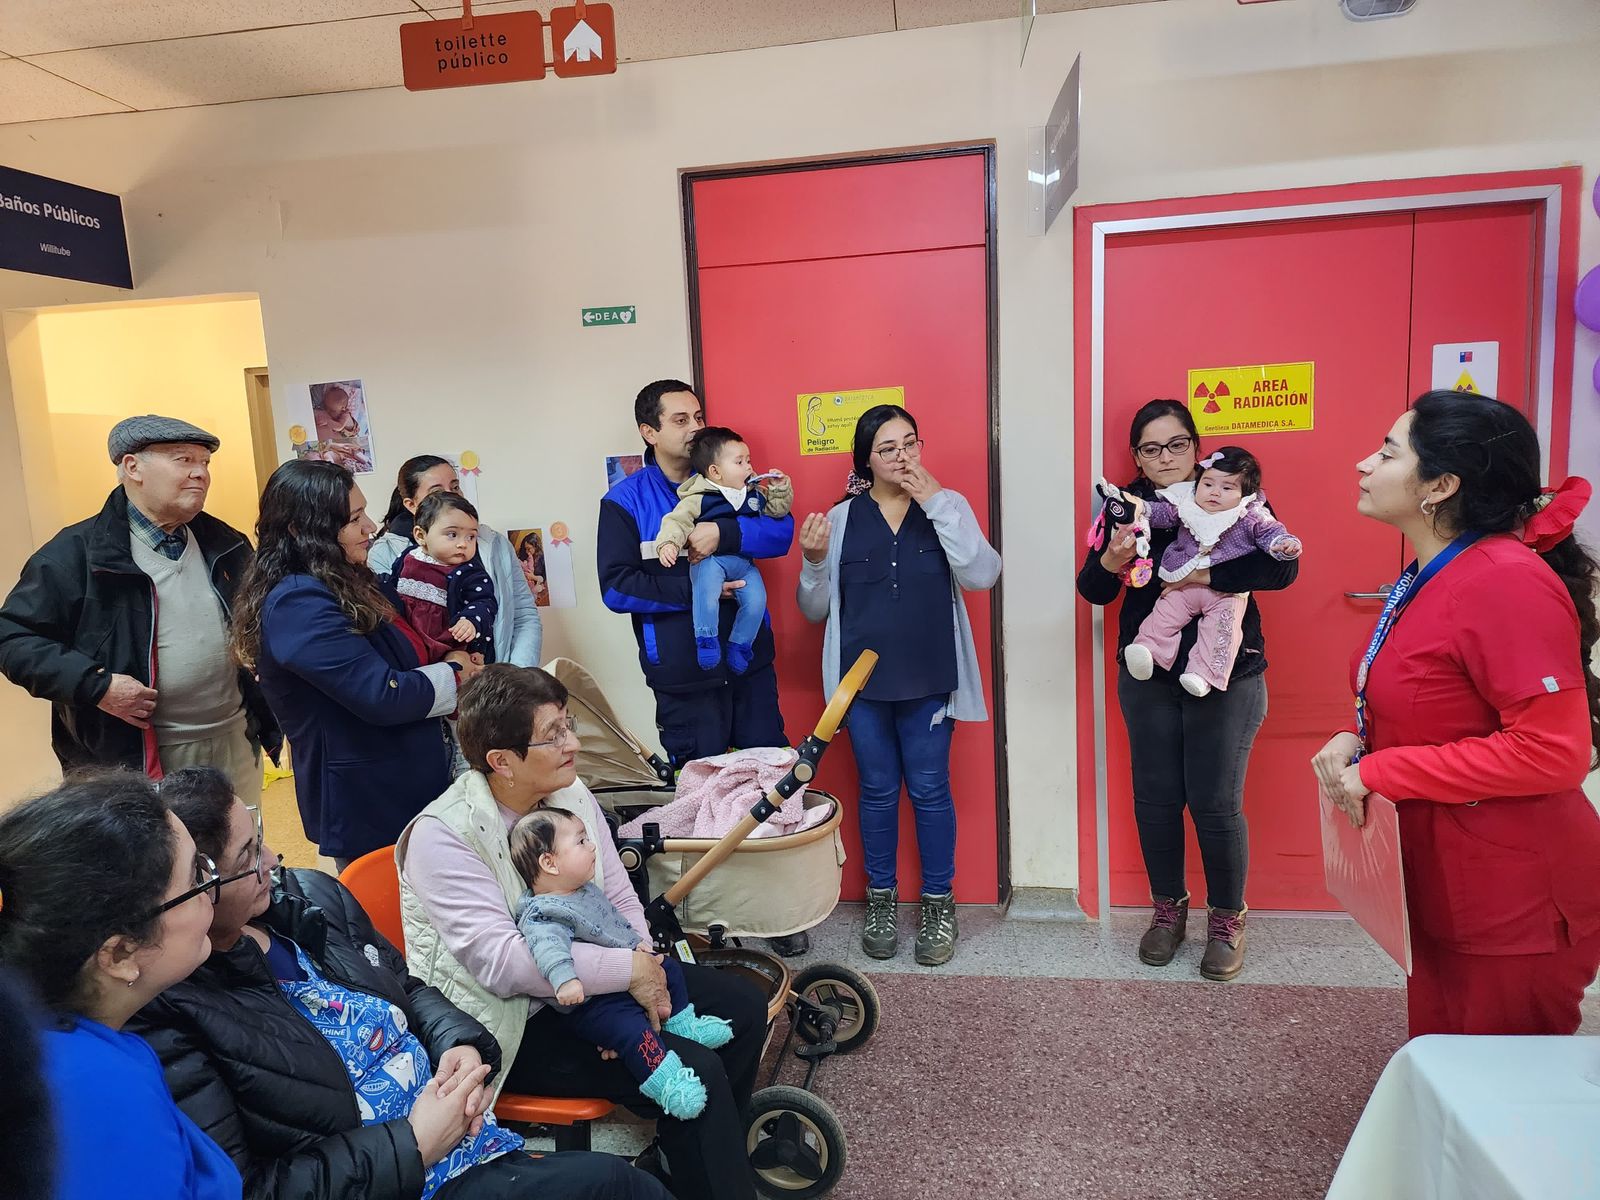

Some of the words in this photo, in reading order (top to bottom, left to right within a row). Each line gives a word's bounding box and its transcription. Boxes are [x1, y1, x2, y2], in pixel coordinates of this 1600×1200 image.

[435, 33, 507, 52] toilette
[438, 52, 509, 73] público
[43, 203, 101, 229] Públicos
[595, 311, 619, 321] DEA
[1253, 379, 1288, 393] AREA
[1233, 390, 1308, 409] RADIACIÓN
[1231, 420, 1279, 430] DATAMEDICA
[1281, 419, 1296, 427] S.A.
[807, 438, 835, 446] Peligro
[1383, 572, 1414, 615] HOSPITAL
[321, 1027, 346, 1037] SHINE
